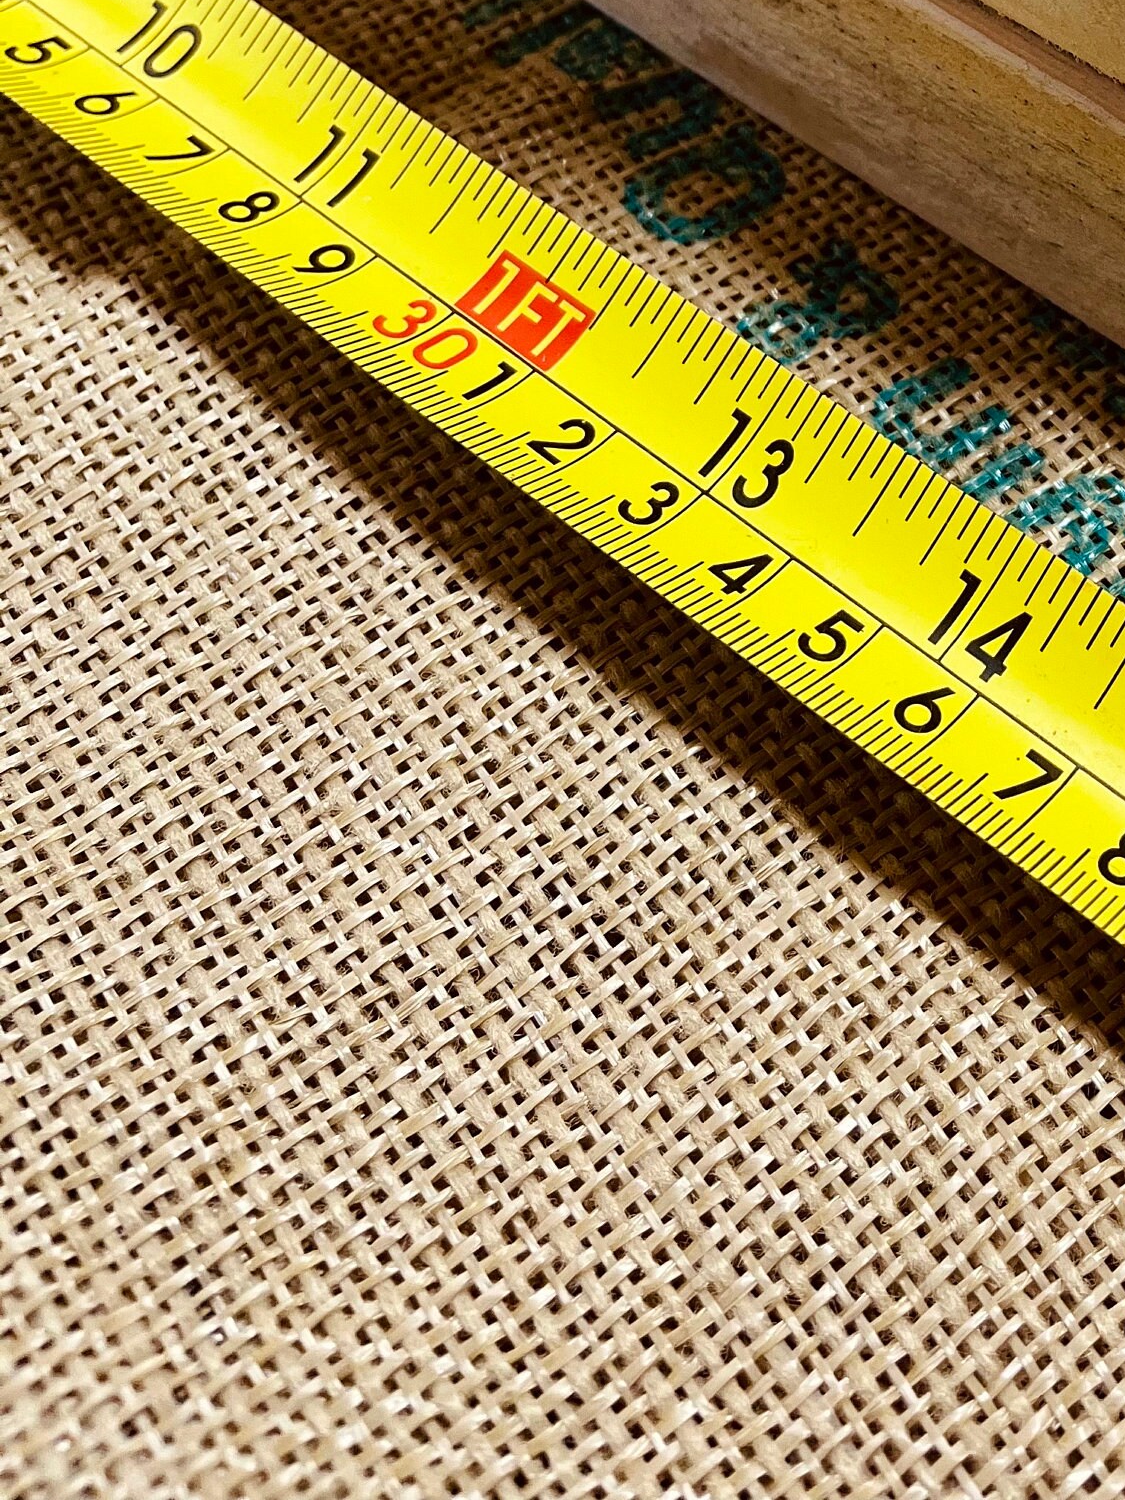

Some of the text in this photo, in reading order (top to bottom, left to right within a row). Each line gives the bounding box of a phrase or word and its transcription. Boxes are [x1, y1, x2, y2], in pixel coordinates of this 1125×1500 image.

[3, 35, 72, 66] 5
[73, 90, 138, 117] 6
[143, 134, 217, 162] 7
[217, 190, 281, 224] 8
[291, 243, 357, 277] 9
[371, 299, 480, 371] 30
[460, 360, 518, 402] 1
[526, 417, 597, 467] 2
[616, 480, 682, 527] 3
[707, 553, 774, 596] 4
[797, 608, 867, 663] 5
[892, 686, 957, 735] 6
[992, 748, 1064, 801] 7
[116, 0, 203, 79] 10
[292, 124, 381, 209] 11
[697, 407, 796, 510] 13
[926, 568, 1034, 684] 14
